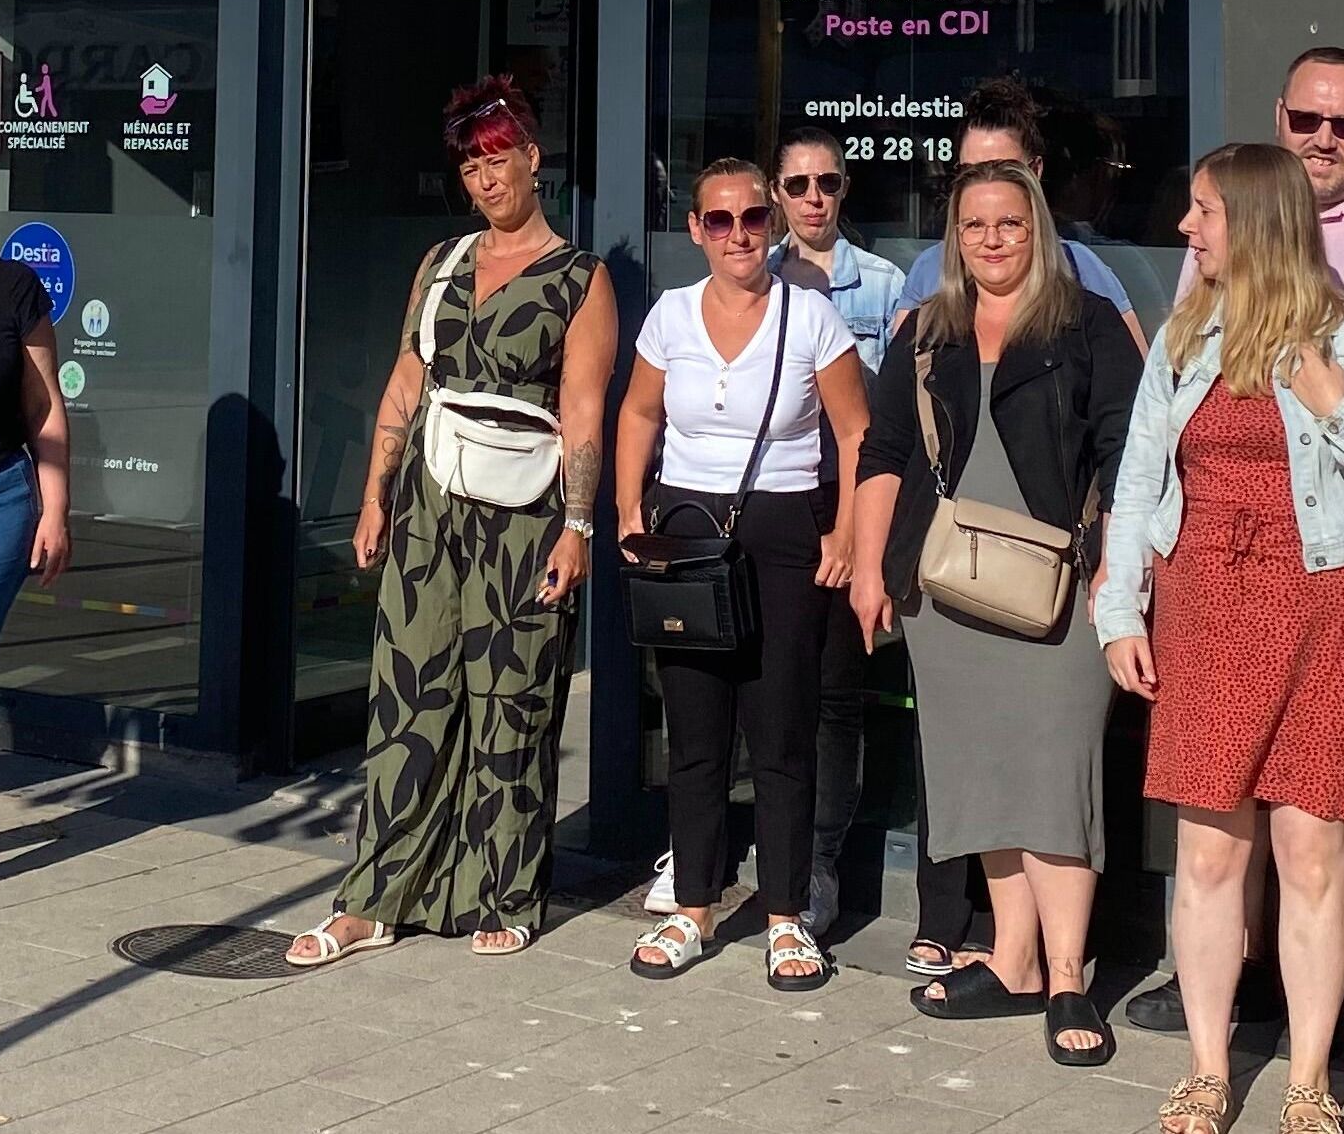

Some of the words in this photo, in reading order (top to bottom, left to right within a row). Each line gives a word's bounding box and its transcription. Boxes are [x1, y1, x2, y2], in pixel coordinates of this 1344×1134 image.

[825, 14, 893, 37] Poste
[901, 19, 931, 36] en
[940, 10, 989, 35] CDI
[123, 120, 173, 135] MÉNAGE
[176, 123, 192, 136] ET
[7, 134, 66, 150] SPÉCIALISÉ
[123, 138, 189, 151] REPASSAGE
[844, 136, 875, 161] 28
[882, 137, 914, 162] 28
[922, 138, 953, 162] 18
[11, 242, 61, 264] Destia
[54, 277, 63, 293] à
[125, 456, 159, 473] d'être
